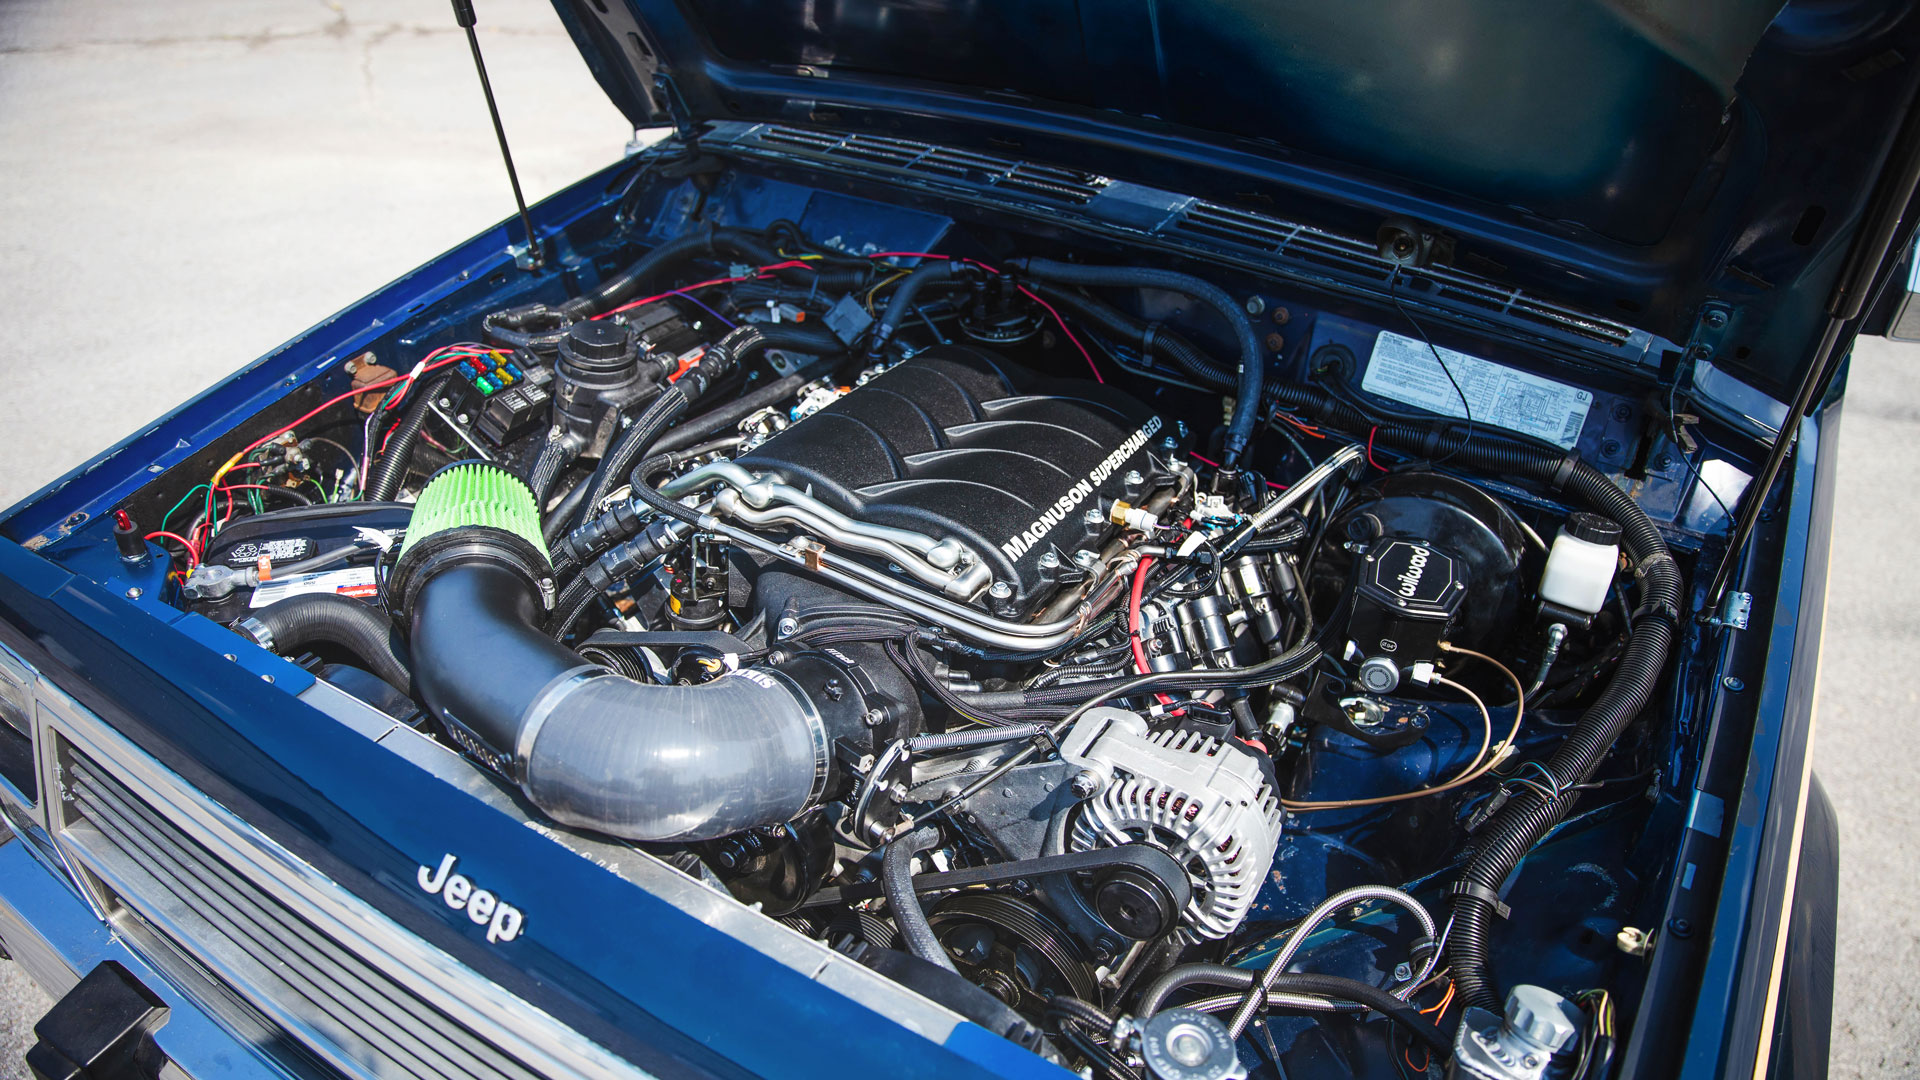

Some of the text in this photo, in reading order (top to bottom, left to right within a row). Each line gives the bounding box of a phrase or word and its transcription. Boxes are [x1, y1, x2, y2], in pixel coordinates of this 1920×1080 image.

[1576, 390, 1588, 401] GJ
[1001, 415, 1162, 563] MAGNUSON SUPERCHARGED
[1398, 545, 1431, 597] wilwood
[417, 853, 522, 944] Jeep
